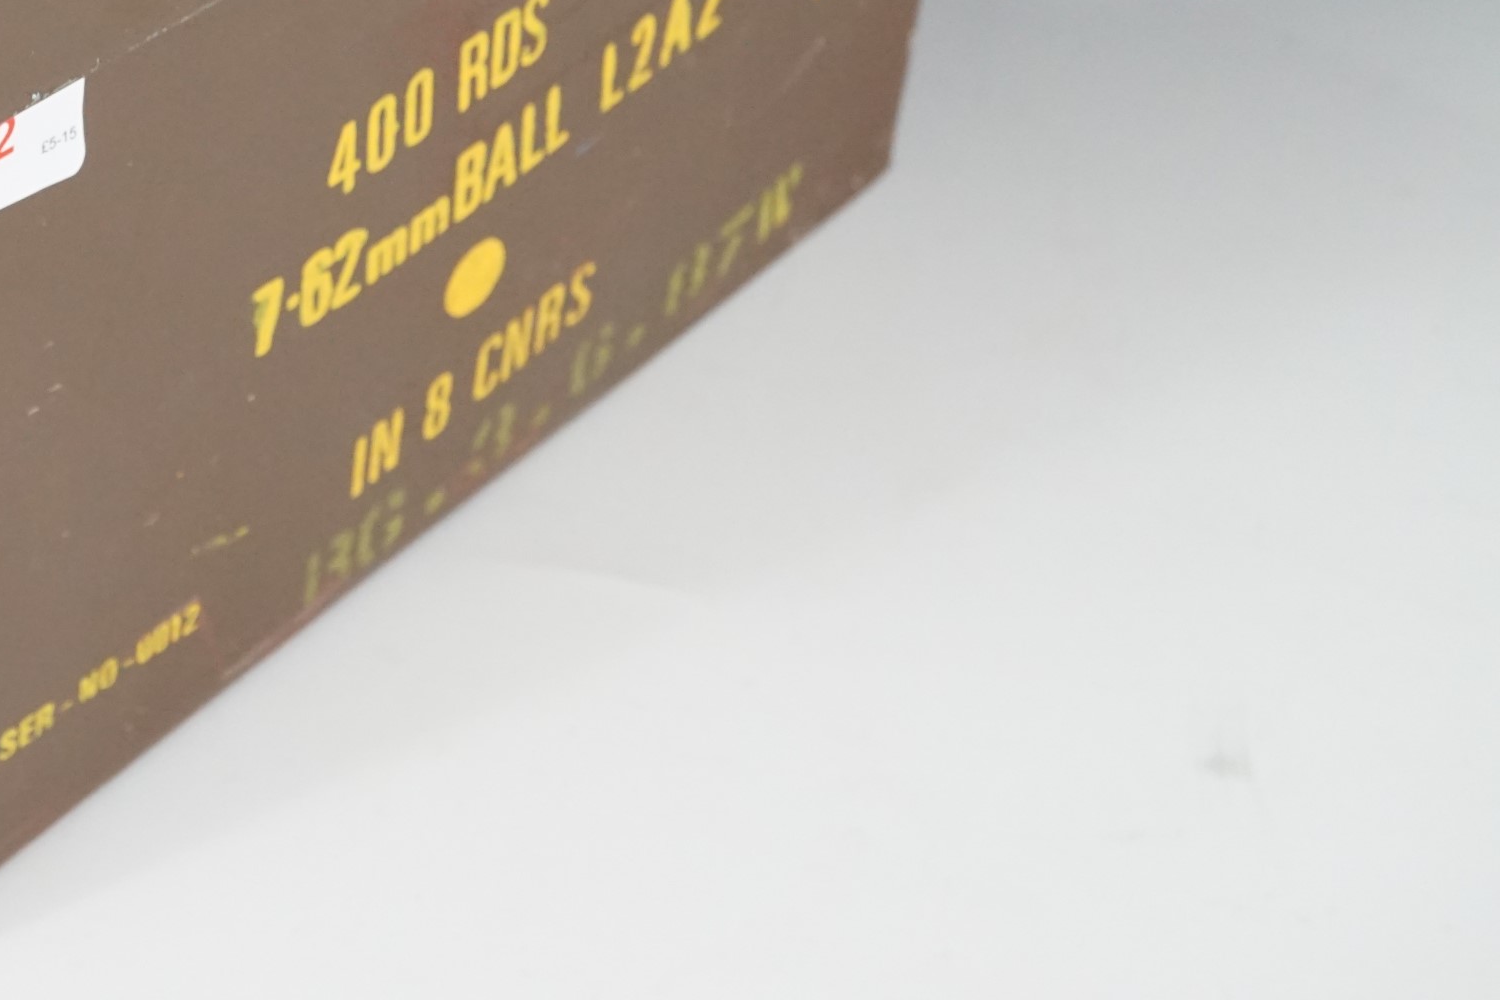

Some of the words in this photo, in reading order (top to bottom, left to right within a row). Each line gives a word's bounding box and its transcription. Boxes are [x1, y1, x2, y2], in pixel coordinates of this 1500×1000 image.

[326, 67, 435, 194] 400
[349, 407, 405, 498] IN
[421, 371, 454, 441] 8
[471, 261, 598, 401] CNRS
